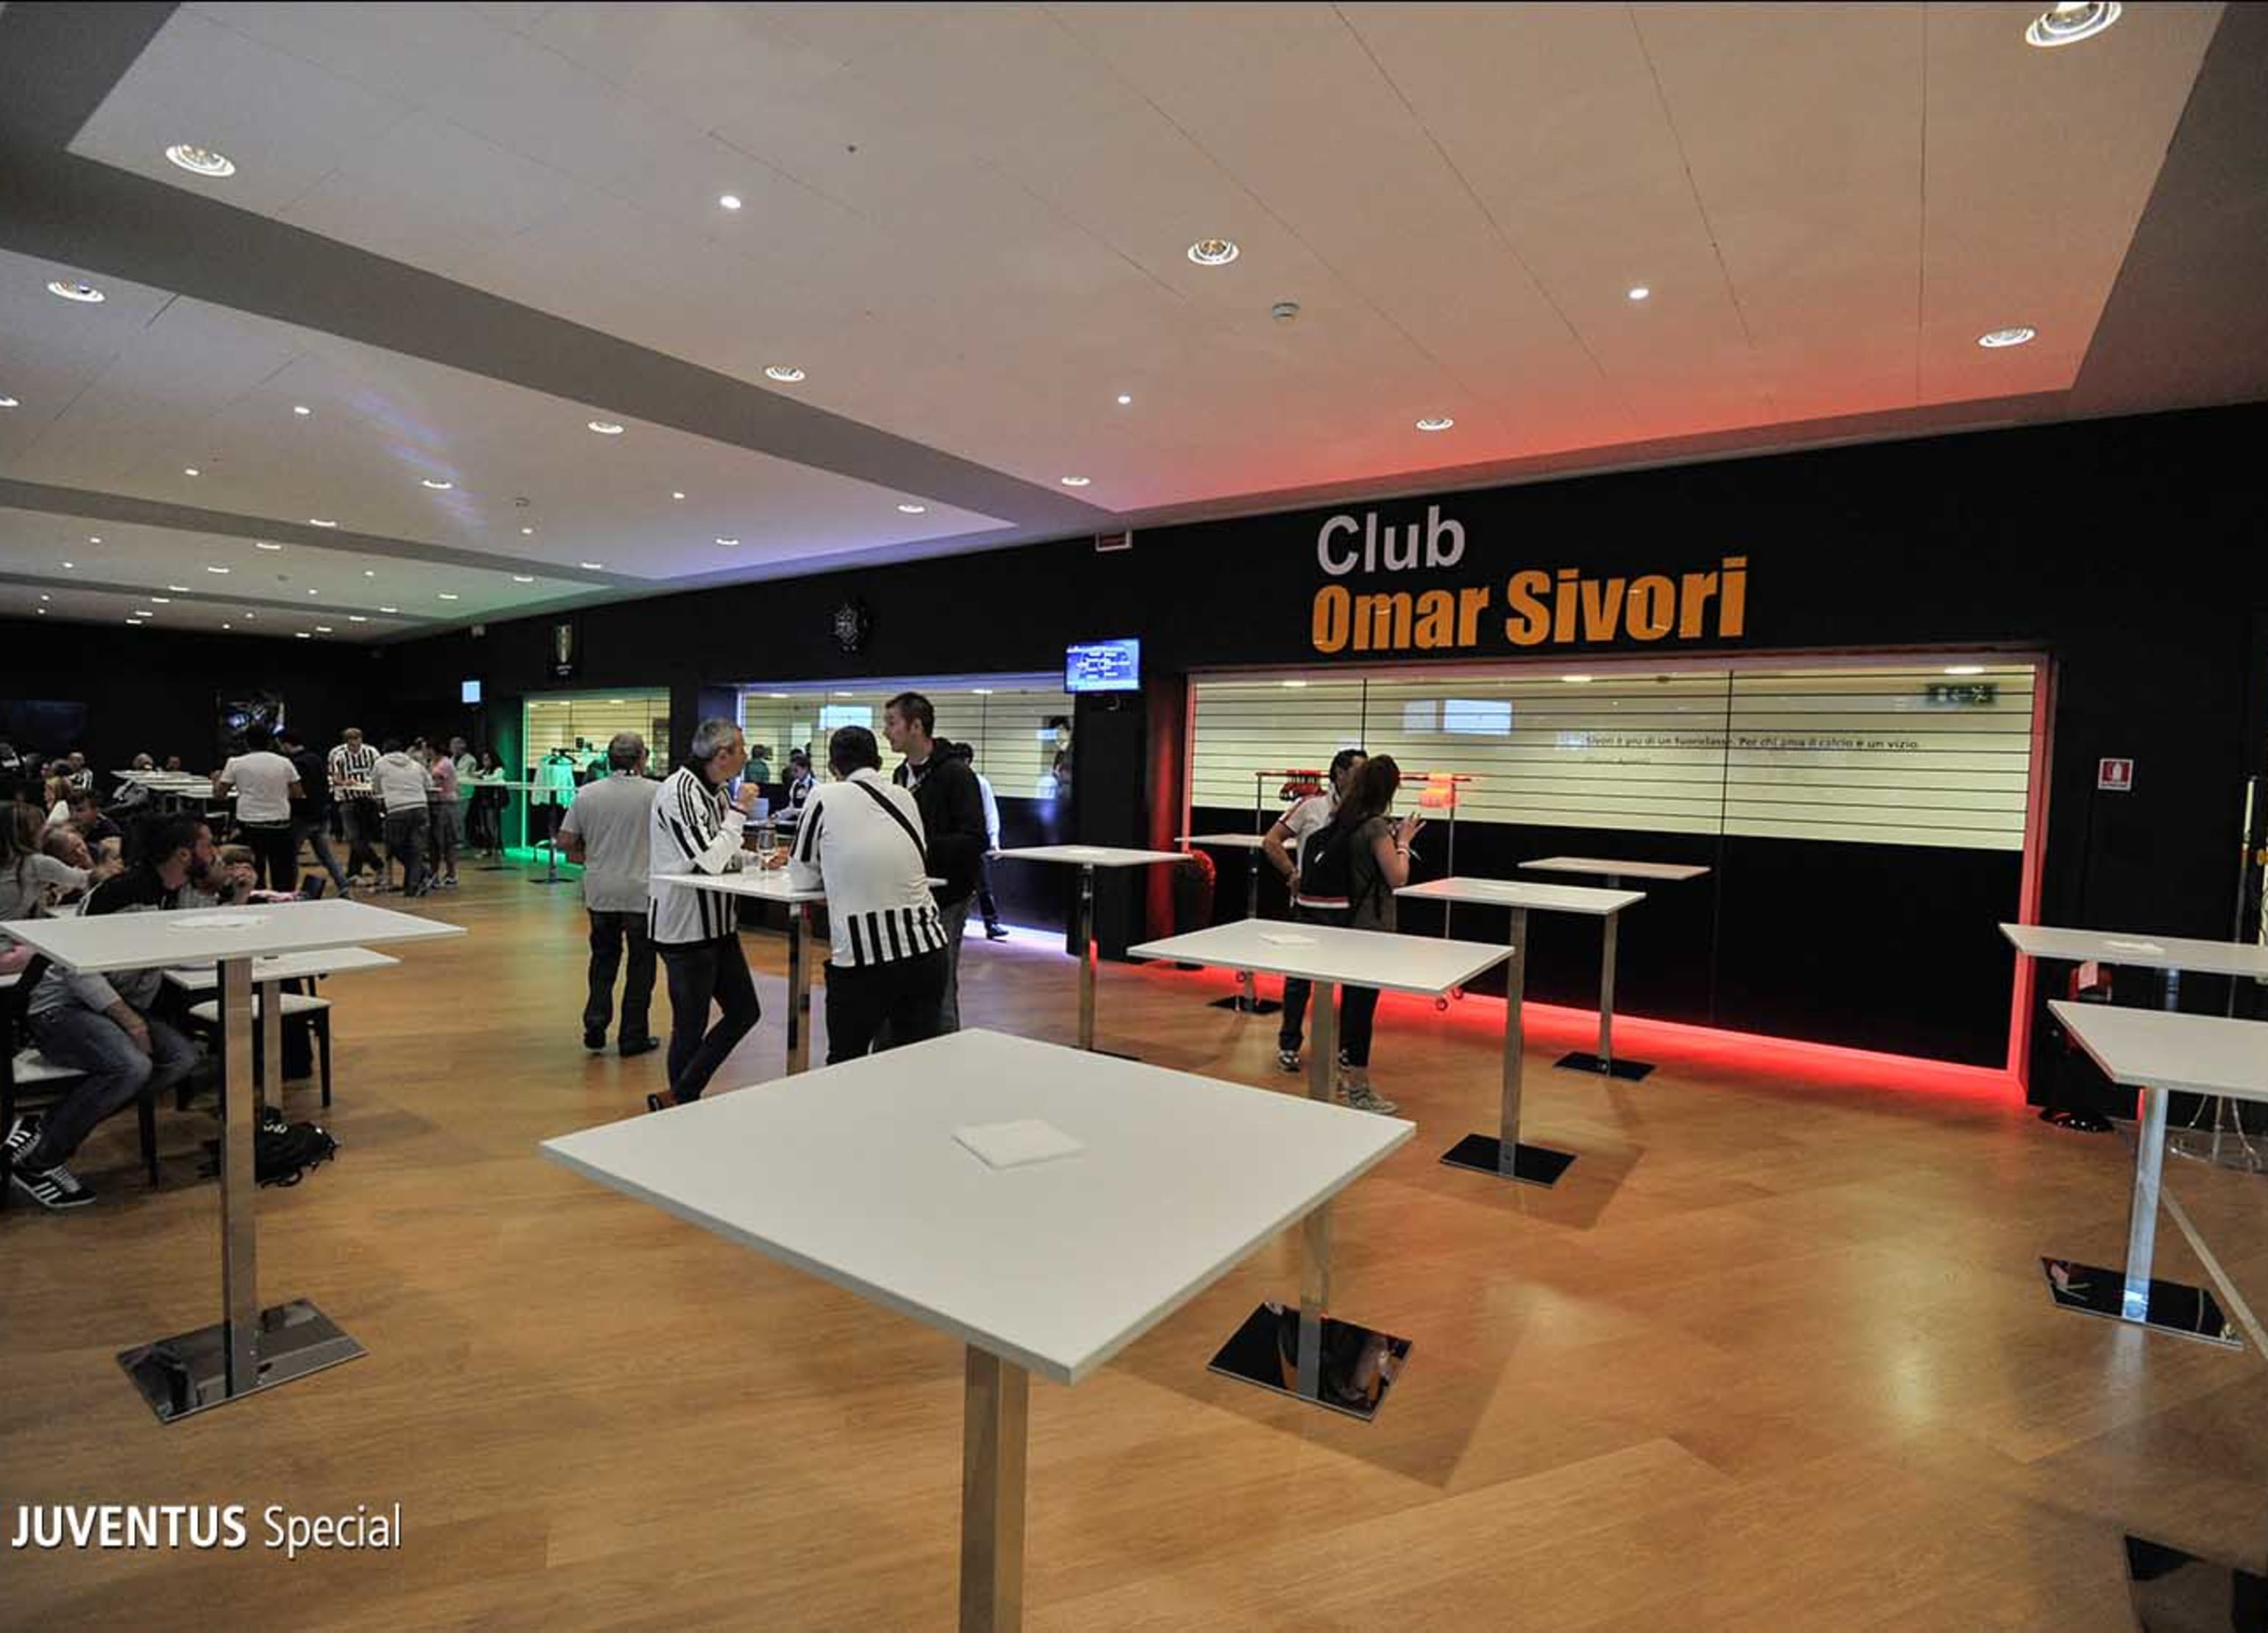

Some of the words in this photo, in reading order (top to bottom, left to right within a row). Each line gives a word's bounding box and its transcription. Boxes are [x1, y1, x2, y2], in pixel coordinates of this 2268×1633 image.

[1317, 506, 1465, 575] Club
[1312, 585, 1490, 653] Omar
[1505, 556, 1747, 647] Sivori
[1866, 739, 1886, 749] un
